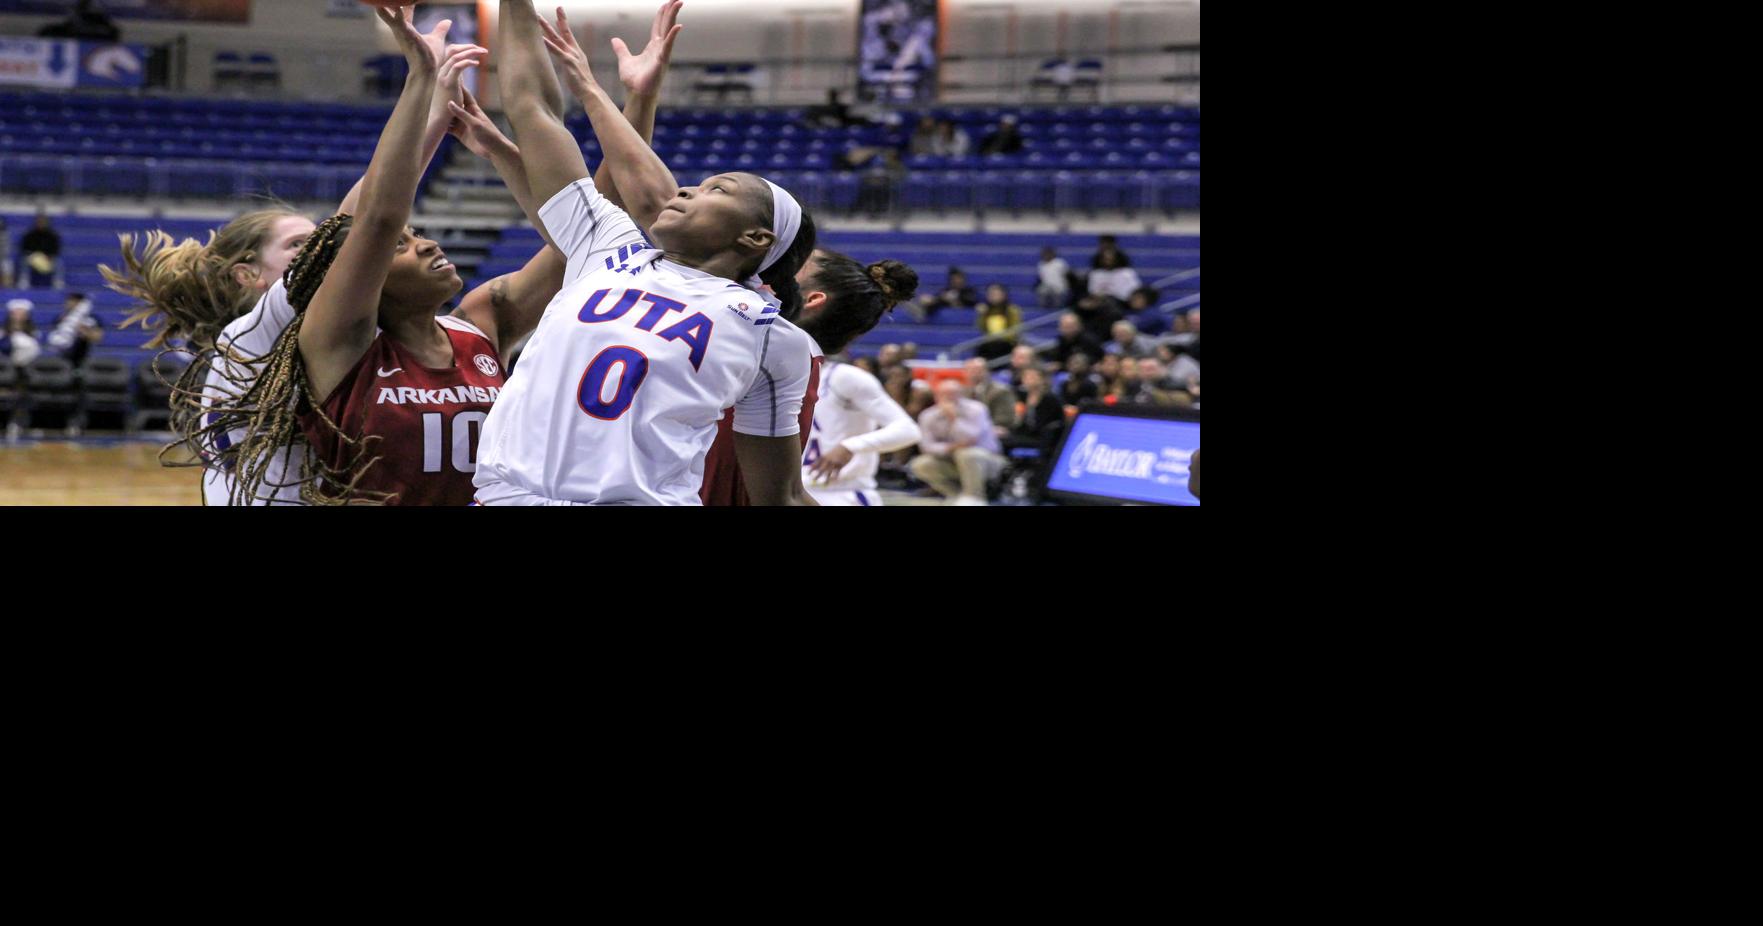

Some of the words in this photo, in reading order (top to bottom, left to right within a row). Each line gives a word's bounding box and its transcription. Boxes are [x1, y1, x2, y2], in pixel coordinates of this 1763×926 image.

[577, 287, 714, 373] UTA
[576, 344, 649, 421] 0
[422, 411, 489, 473] 10
